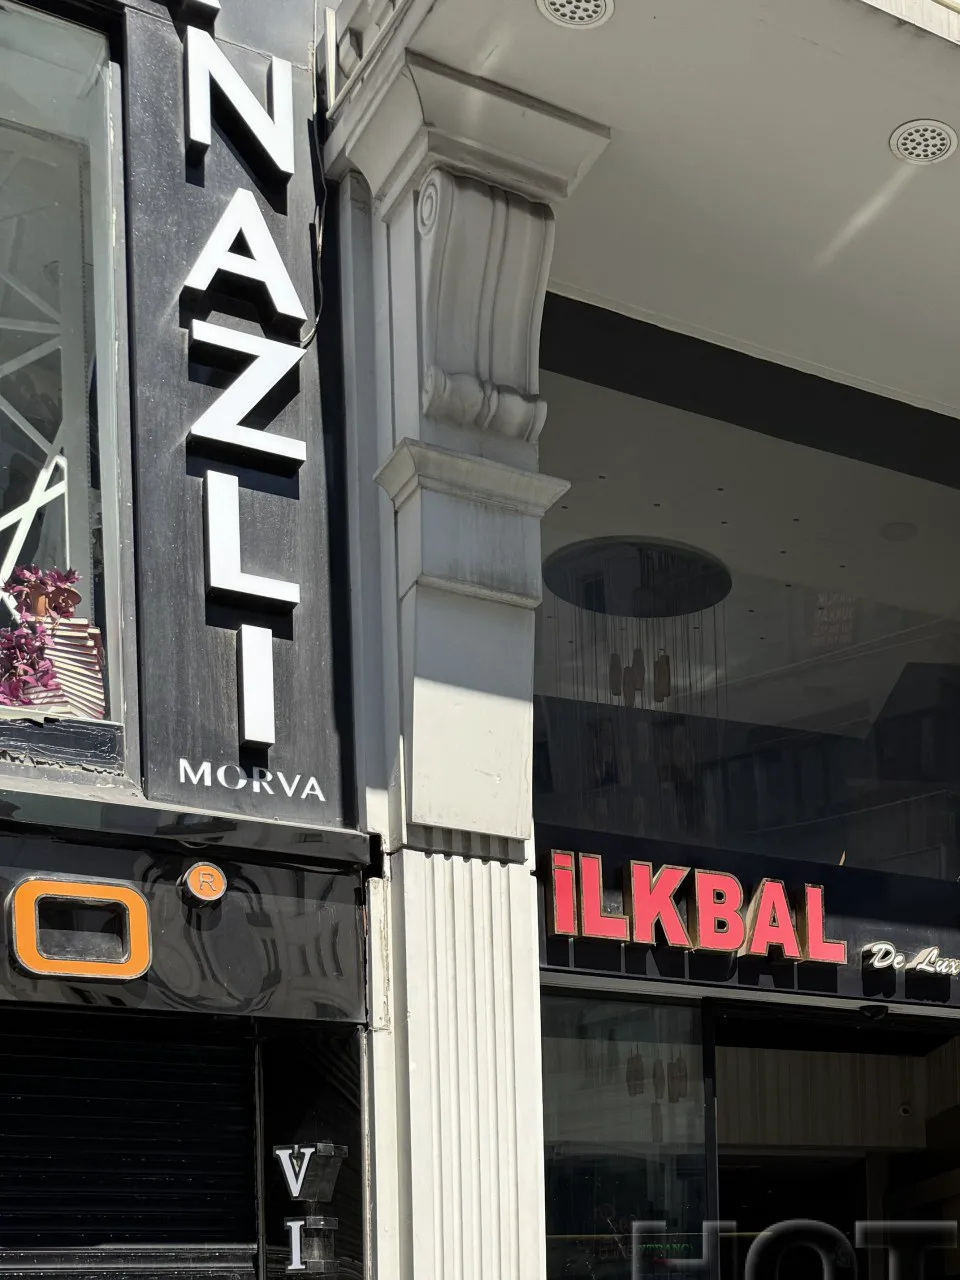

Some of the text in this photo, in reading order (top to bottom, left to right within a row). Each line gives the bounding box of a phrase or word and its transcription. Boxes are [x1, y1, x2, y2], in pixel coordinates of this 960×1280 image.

[183, 0, 309, 745] NAZLI
[178, 757, 327, 802] MORVA
[865, 940, 905, 969] De
